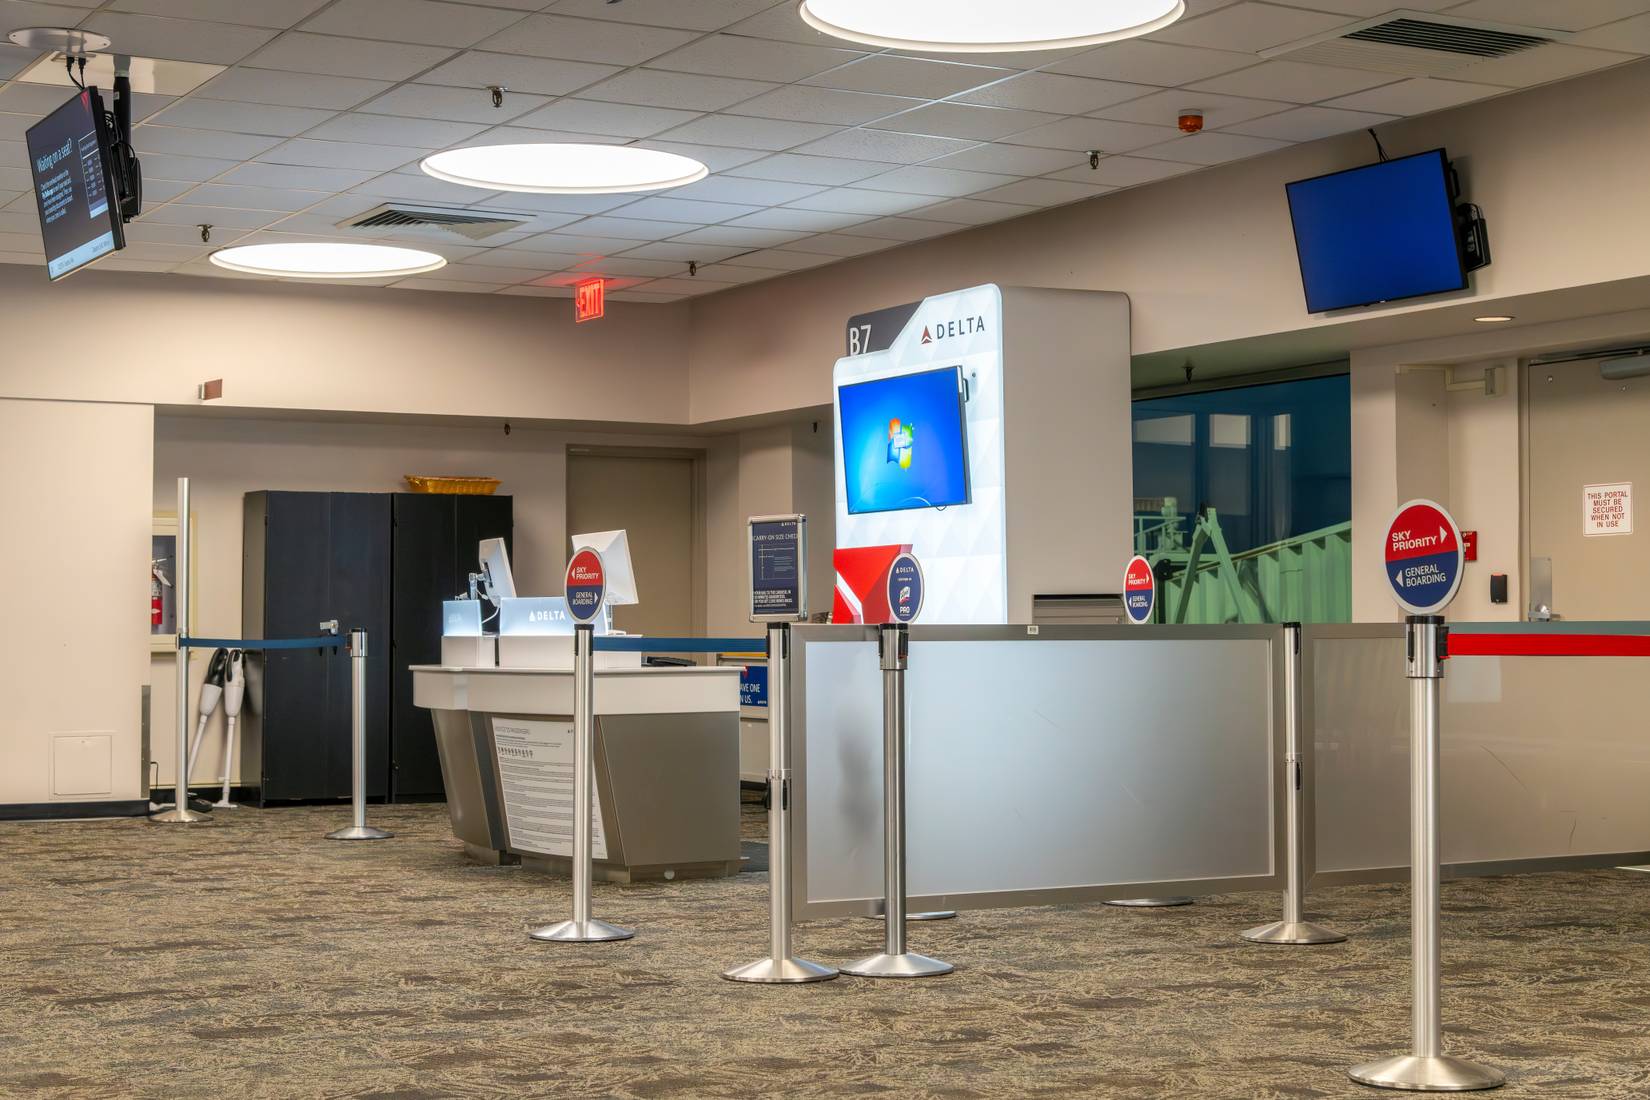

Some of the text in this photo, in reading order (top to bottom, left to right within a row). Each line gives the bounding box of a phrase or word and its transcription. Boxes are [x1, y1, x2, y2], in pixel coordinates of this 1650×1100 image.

[37, 154, 53, 173] Waiting
[579, 283, 600, 318] EXIT
[937, 315, 985, 340] DELTA
[849, 324, 872, 355] B7
[1587, 491, 1629, 500] THIS PORTAL
[1593, 498, 1622, 507] MUST BE
[1592, 506, 1623, 514] SECURED
[1591, 512, 1625, 521] WHEN NOT
[1605, 520, 1619, 528] USE
[1392, 530, 1411, 542] SKY
[1392, 535, 1437, 552] PRIORITY
[1405, 563, 1439, 577] GENERAL
[576, 572, 600, 580] PRIORITY
[1406, 573, 1446, 587] BOARDING
[573, 598, 593, 606] BOARDING
[537, 610, 565, 621] DELTA
[750, 683, 760, 693] ONE
[744, 695, 752, 703] US.
